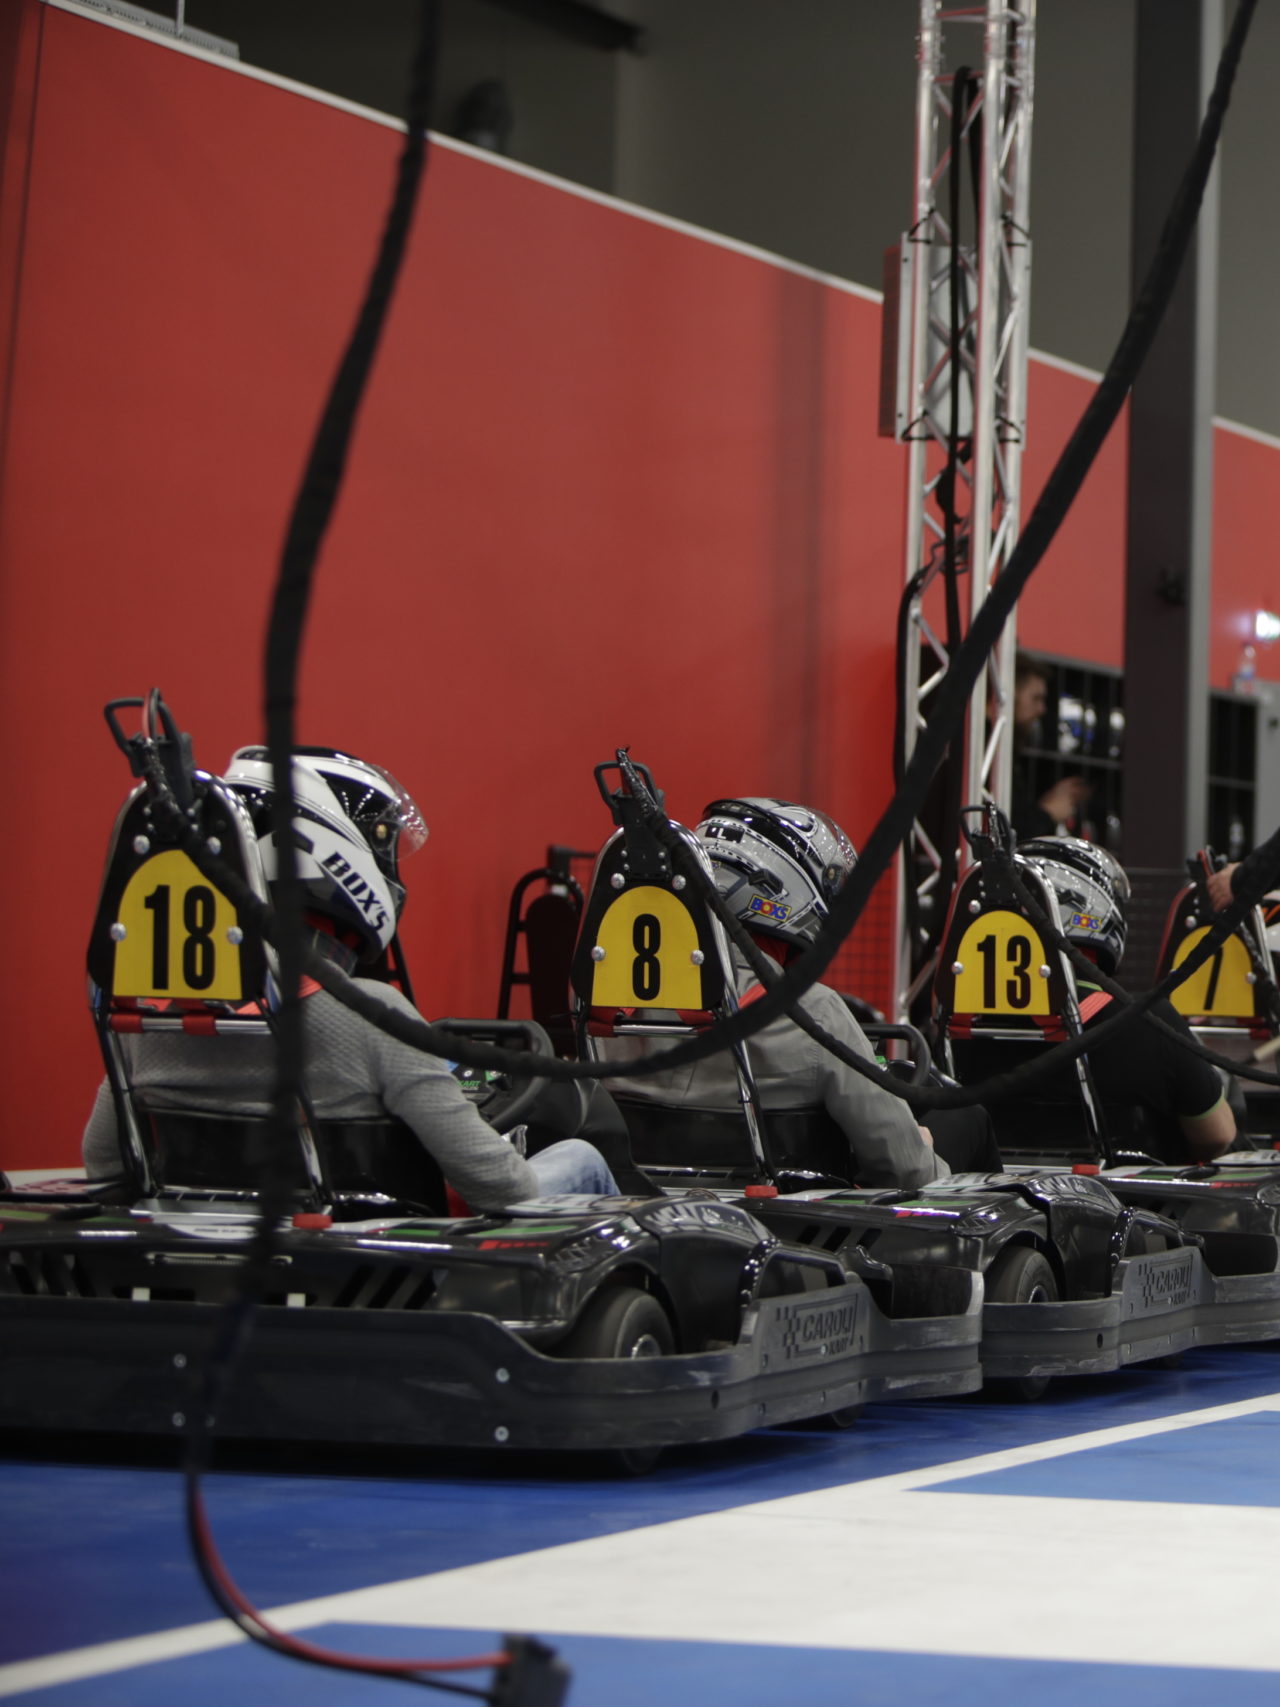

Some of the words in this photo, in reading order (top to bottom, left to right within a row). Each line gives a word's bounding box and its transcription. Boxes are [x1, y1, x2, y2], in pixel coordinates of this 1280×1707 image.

[143, 884, 216, 991] 18
[632, 913, 661, 1001] 8
[977, 934, 1031, 1009] 13
